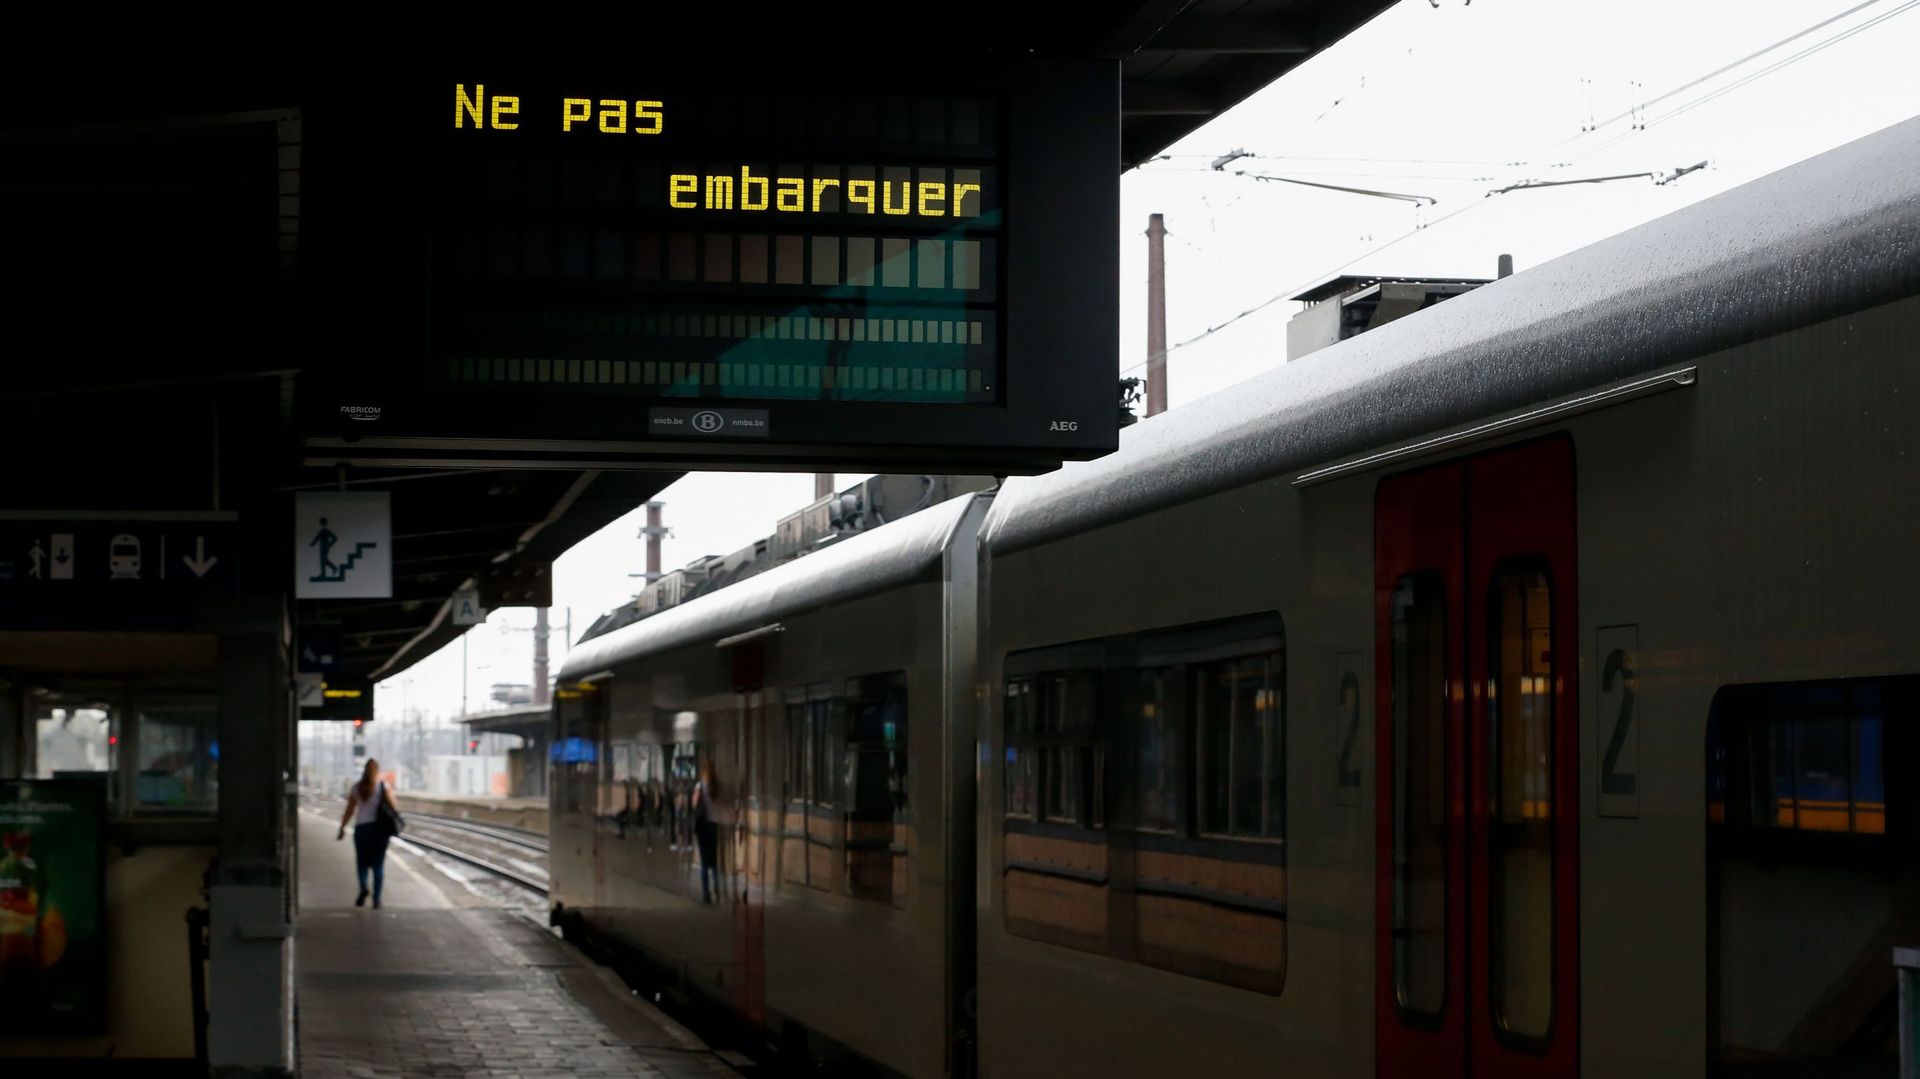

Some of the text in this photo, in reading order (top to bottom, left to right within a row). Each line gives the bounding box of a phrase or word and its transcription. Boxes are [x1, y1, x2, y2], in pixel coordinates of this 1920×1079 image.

[455, 83, 664, 135] Ne pas
[668, 165, 982, 218] embarquer
[340, 406, 381, 414] FABRICOM
[653, 417, 684, 425] sncb.be
[732, 419, 765, 427] nmbs.be
[1049, 421, 1078, 431] AEG
[461, 600, 474, 617] A
[1339, 671, 1361, 787] 2
[1601, 649, 1636, 795] 2
